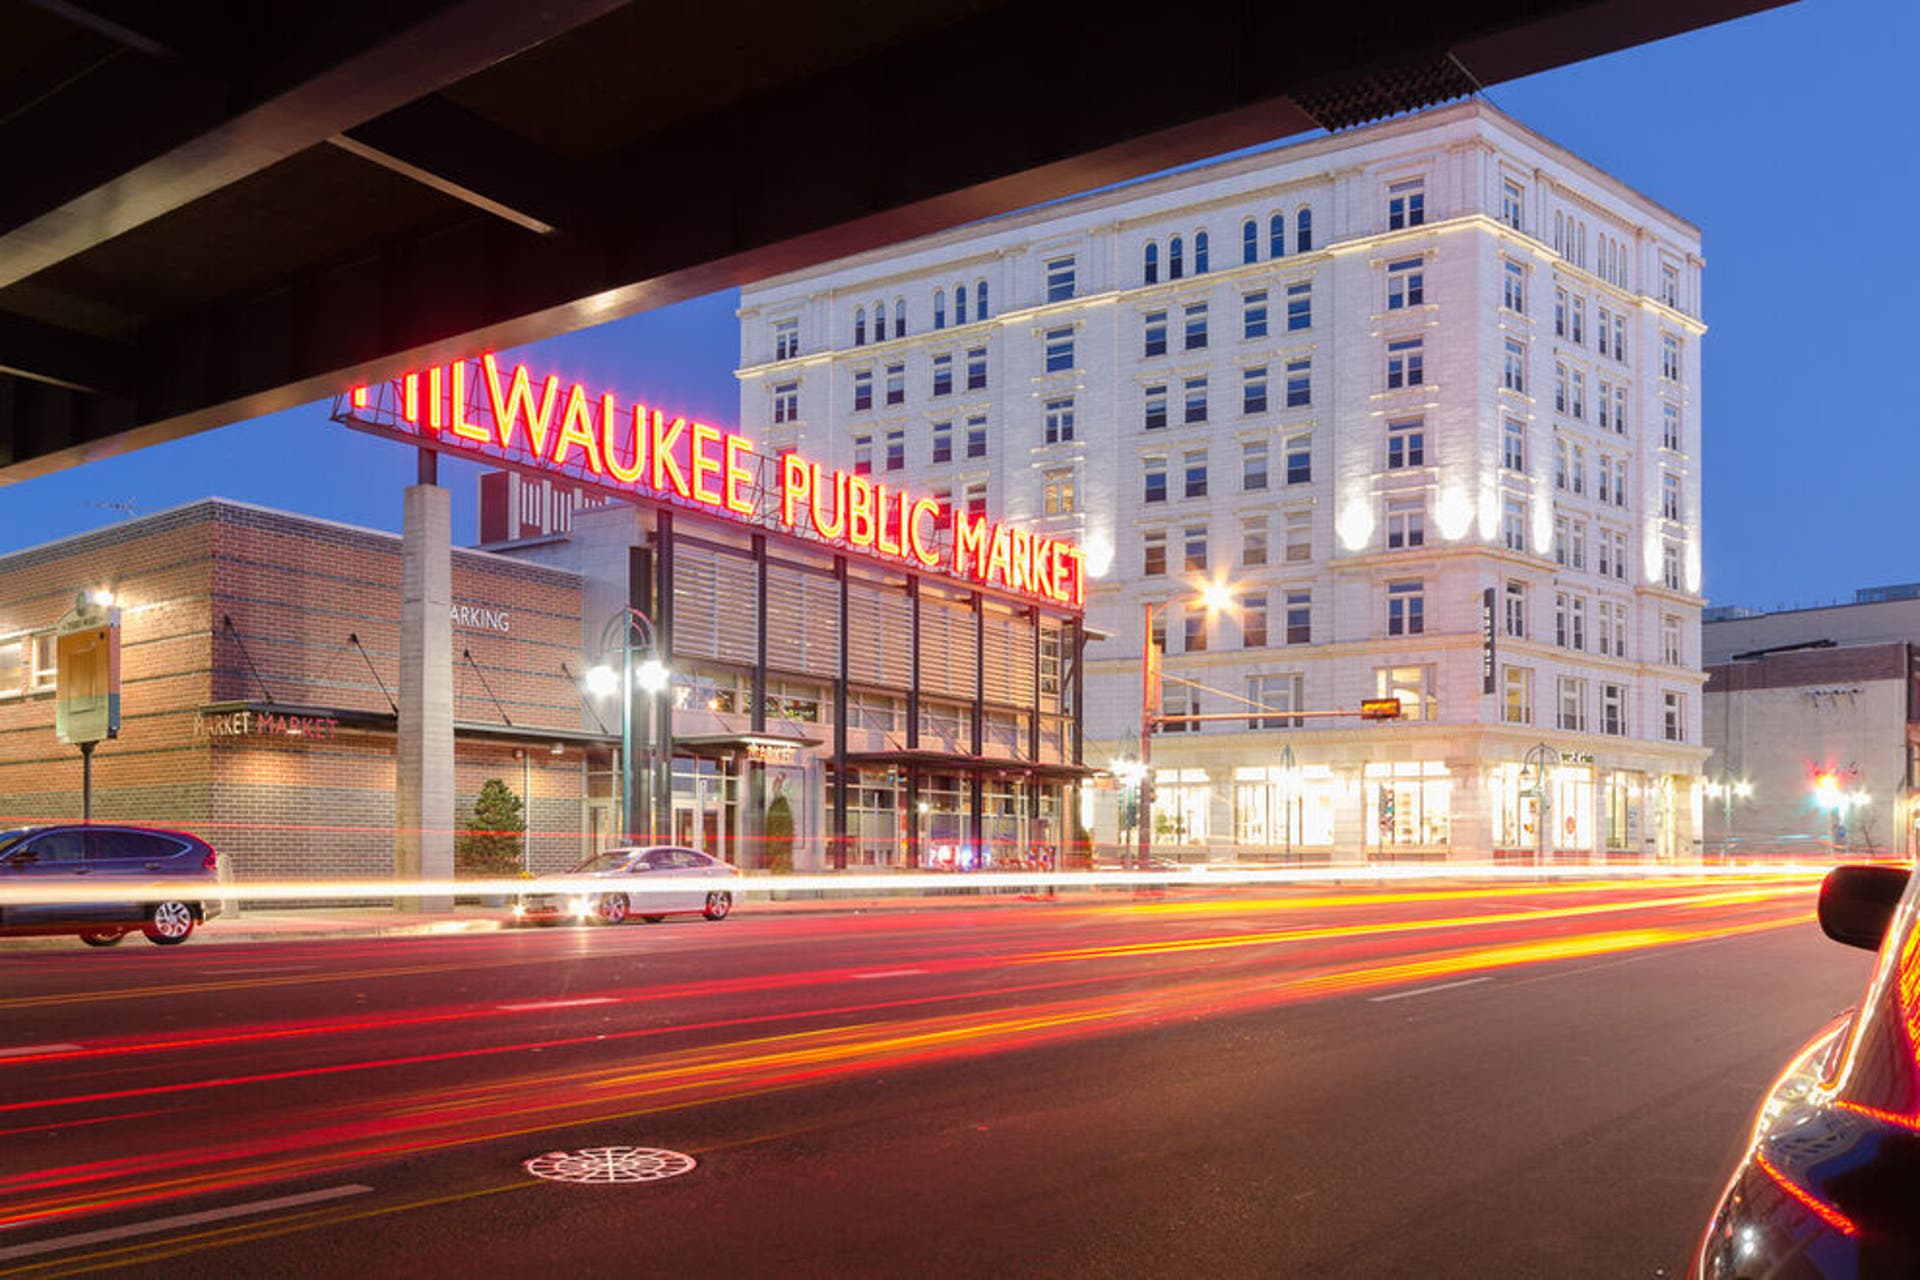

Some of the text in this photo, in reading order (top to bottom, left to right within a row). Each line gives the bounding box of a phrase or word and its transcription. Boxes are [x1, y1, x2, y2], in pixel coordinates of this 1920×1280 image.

[351, 351, 1088, 606] ILWAUKEE PUBLIC MARKET
[450, 605, 510, 632] ARKING
[257, 713, 339, 741] MARKET
